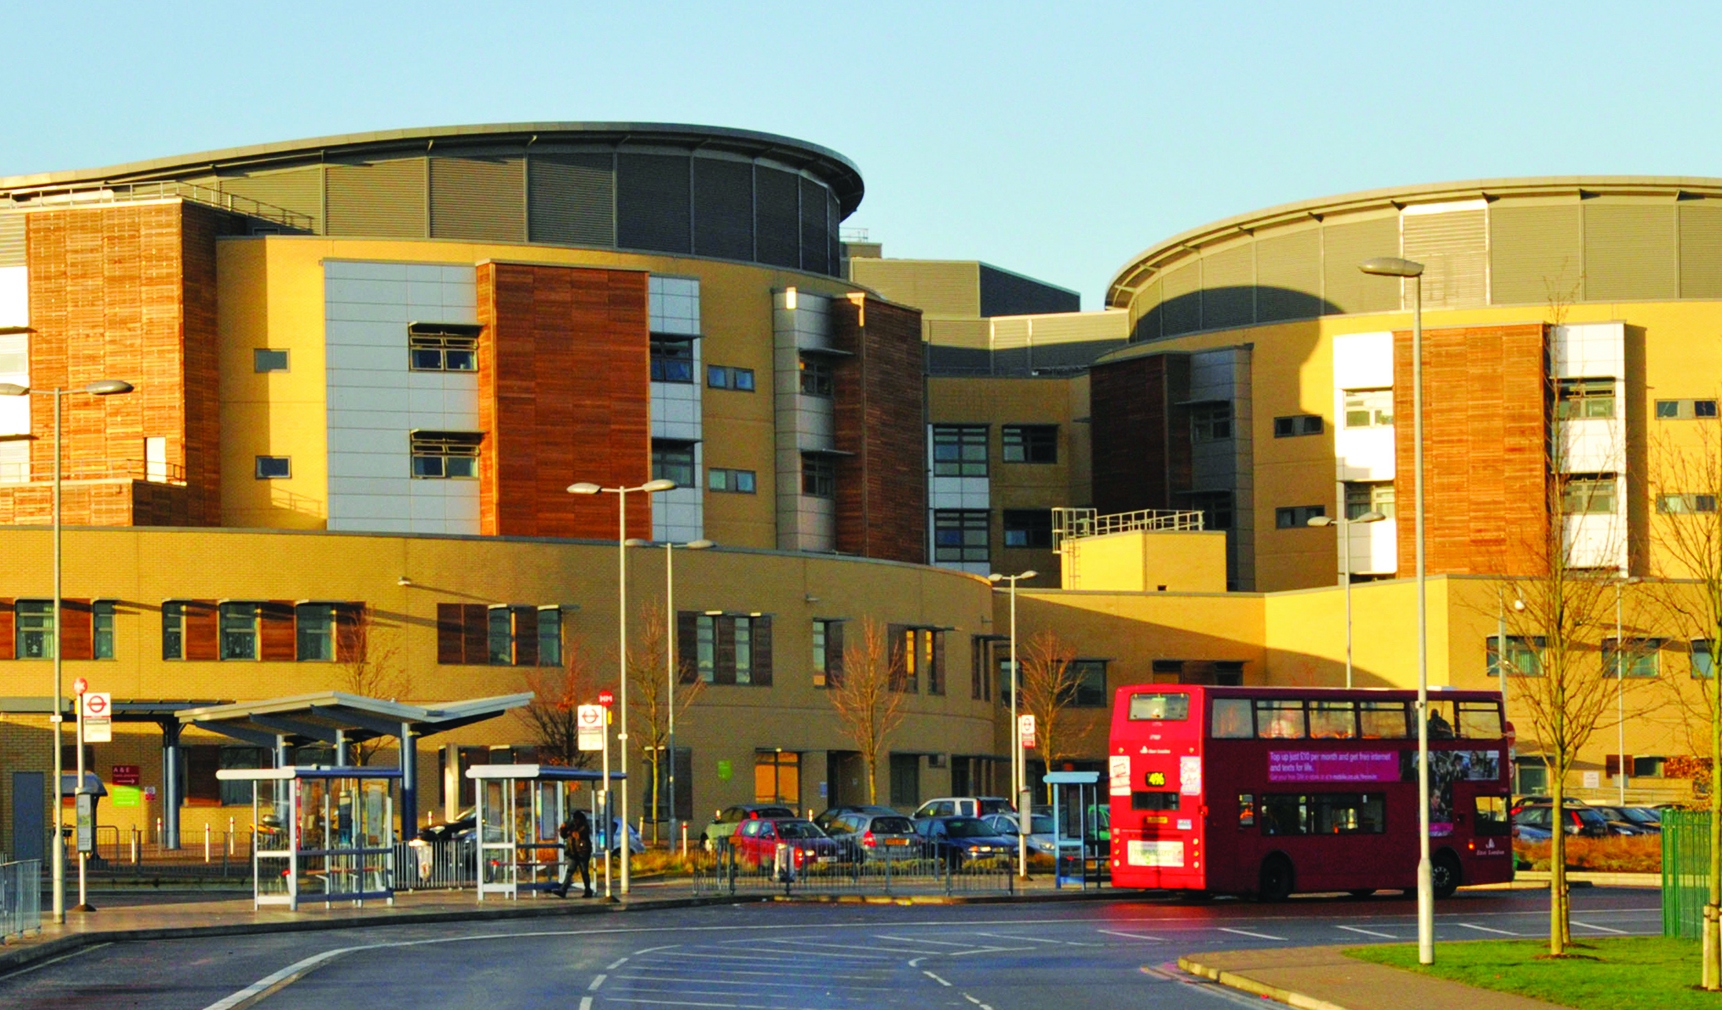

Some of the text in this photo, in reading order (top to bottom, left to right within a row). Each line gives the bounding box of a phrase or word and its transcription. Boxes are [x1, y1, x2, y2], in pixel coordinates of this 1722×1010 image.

[1270, 752, 1280, 762] Top
[1281, 754, 1289, 762] up
[1289, 752, 1300, 762] just
[1311, 754, 1319, 762] per
[1320, 752, 1338, 761] month
[1338, 752, 1349, 761] and
[1349, 752, 1359, 763] get
[1359, 751, 1370, 761] free
[1370, 752, 1391, 761] internet
[1270, 763, 1281, 772] and
[1282, 764, 1295, 772] texts
[1148, 772, 1165, 786] 496
